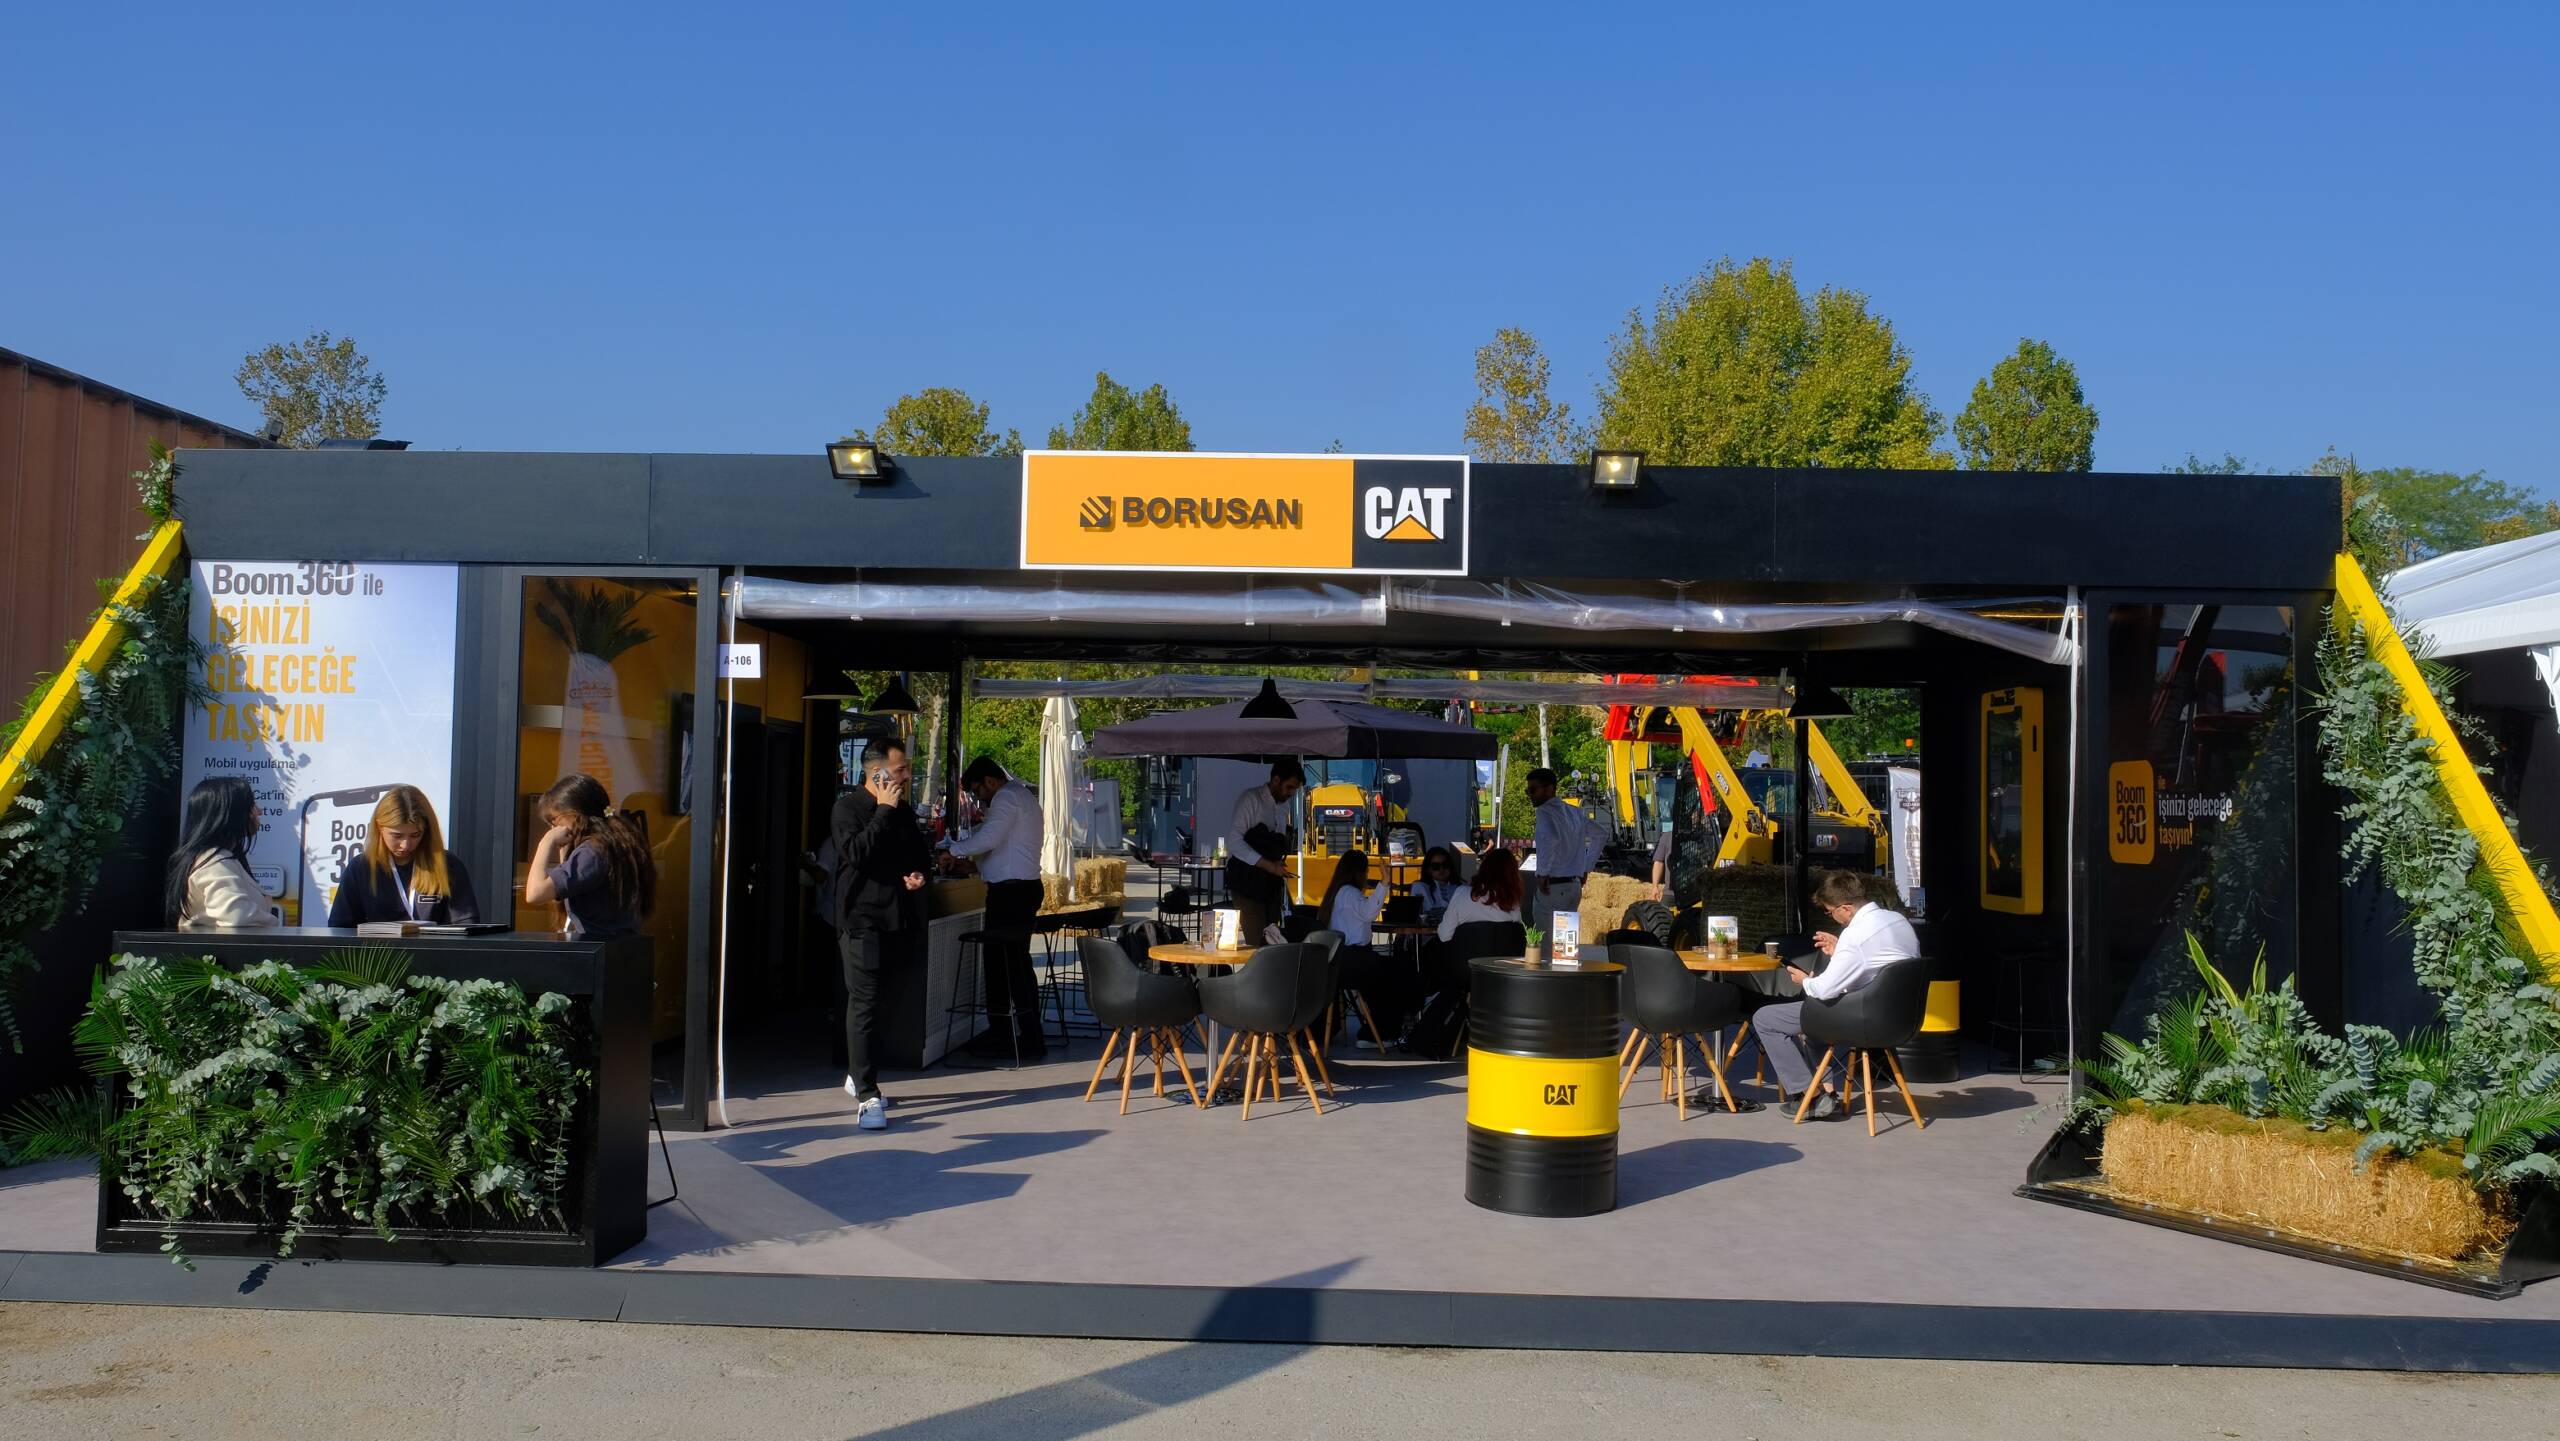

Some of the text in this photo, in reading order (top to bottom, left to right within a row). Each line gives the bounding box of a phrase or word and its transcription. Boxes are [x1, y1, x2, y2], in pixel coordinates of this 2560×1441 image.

[1122, 496, 1299, 526] BORUSAN
[1365, 486, 1451, 540] CAT
[363, 573, 384, 596] ile
[207, 645, 357, 694] GELECEĞE
[724, 655, 752, 666] A-106
[206, 703, 325, 753] TAŞIYIN
[204, 757, 296, 771] Mobil uygulama
[2116, 781, 2145, 803] Boom
[270, 808, 283, 816] ve
[2159, 792, 2232, 822] işinizi geleceğe
[331, 820, 369, 842] Boo
[2117, 805, 2146, 844] 360
[1815, 834, 1833, 848] CAT
[1544, 1084, 1578, 1105] CAT
